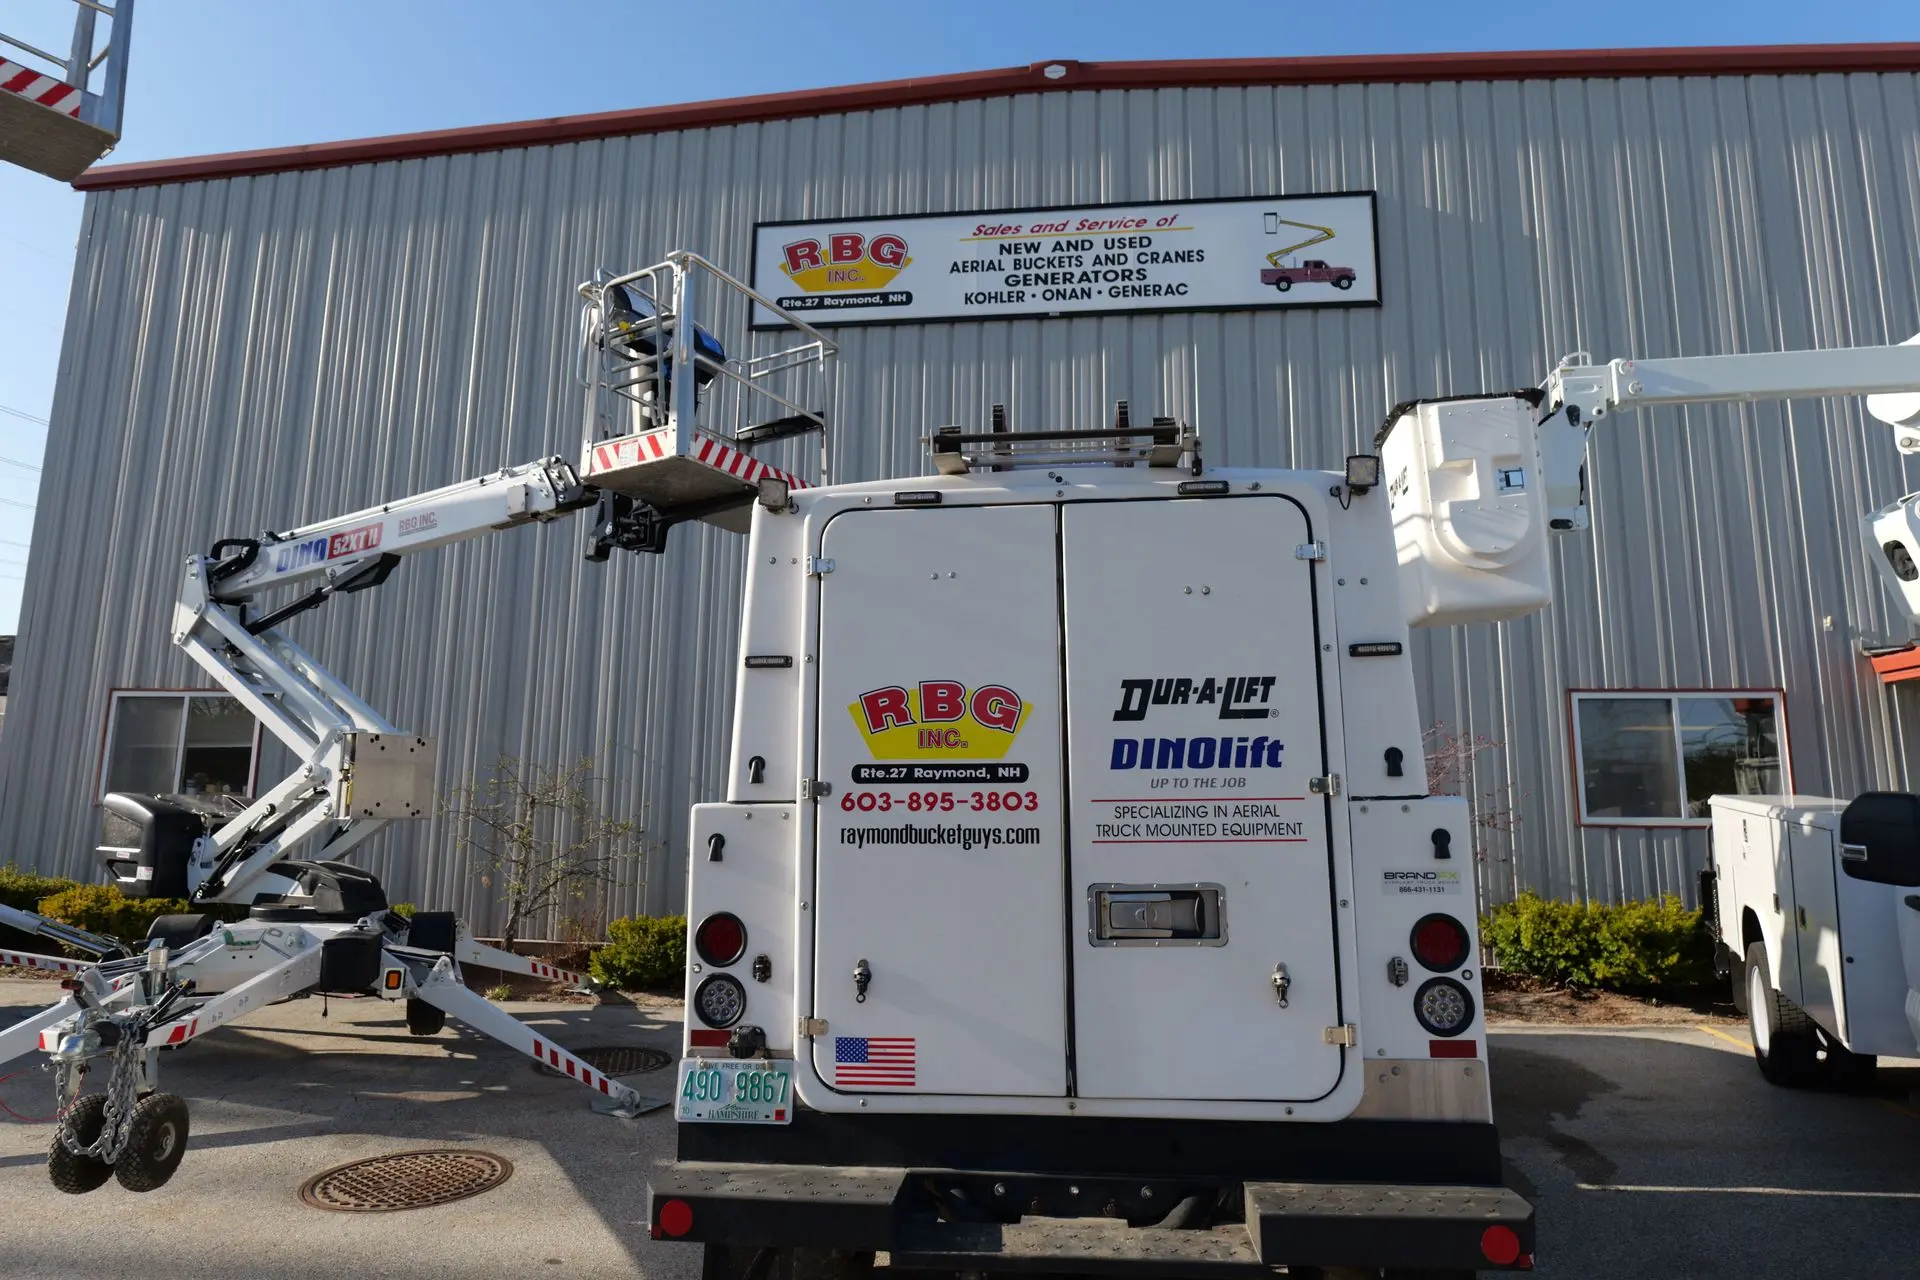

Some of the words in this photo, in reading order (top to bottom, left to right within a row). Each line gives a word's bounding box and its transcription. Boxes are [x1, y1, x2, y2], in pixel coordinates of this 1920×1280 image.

[972, 224, 1022, 237] Sales
[1030, 220, 1069, 234] and
[1075, 216, 1148, 232] Service
[1156, 213, 1180, 228] of
[782, 232, 909, 275] RBG
[999, 241, 1042, 256] NEW
[1051, 239, 1094, 253] AND
[1104, 236, 1153, 250] USED
[950, 260, 1006, 274] AERIAL
[1013, 255, 1084, 271] BUCKETS
[1092, 252, 1129, 267] AND
[1137, 249, 1206, 265] CRANES
[827, 268, 865, 284] INC.
[1004, 267, 1148, 287] GENERATORS
[782, 298, 819, 308] Rte.27
[823, 295, 884, 307] Raymond,
[888, 293, 907, 302] NH
[964, 290, 1026, 305] KOHLER
[1042, 287, 1092, 301] ONAN
[1108, 283, 1189, 298] GENERAC
[398, 516, 418, 532] RBG
[276, 538, 328, 573] DINO
[859, 680, 1022, 734] RBG
[917, 728, 969, 749] INC.
[1110, 736, 1284, 770] DINOlift
[860, 767, 908, 778] Rte.27
[914, 767, 991, 780] Raymond,
[998, 767, 1021, 778] NH
[1150, 778, 1170, 789] UP
[1172, 778, 1189, 789] TO
[1193, 777, 1217, 788] THE
[1220, 777, 1247, 788] JOB
[840, 791, 1039, 812] 603-895-3803
[1114, 805, 1209, 819] SPECIALIZING
[1213, 805, 1228, 818] IN
[1233, 804, 1280, 818] AERIAL
[840, 823, 1040, 850] raymondbucketguys.com
[1096, 823, 1141, 837] TRUCK
[1146, 823, 1217, 837] MOUNTED
[1222, 822, 1303, 836] EQUIPMENT
[682, 1070, 721, 1102] 490
[735, 1071, 789, 1103] 9867
[708, 1108, 760, 1120] HAMPSHIRE
